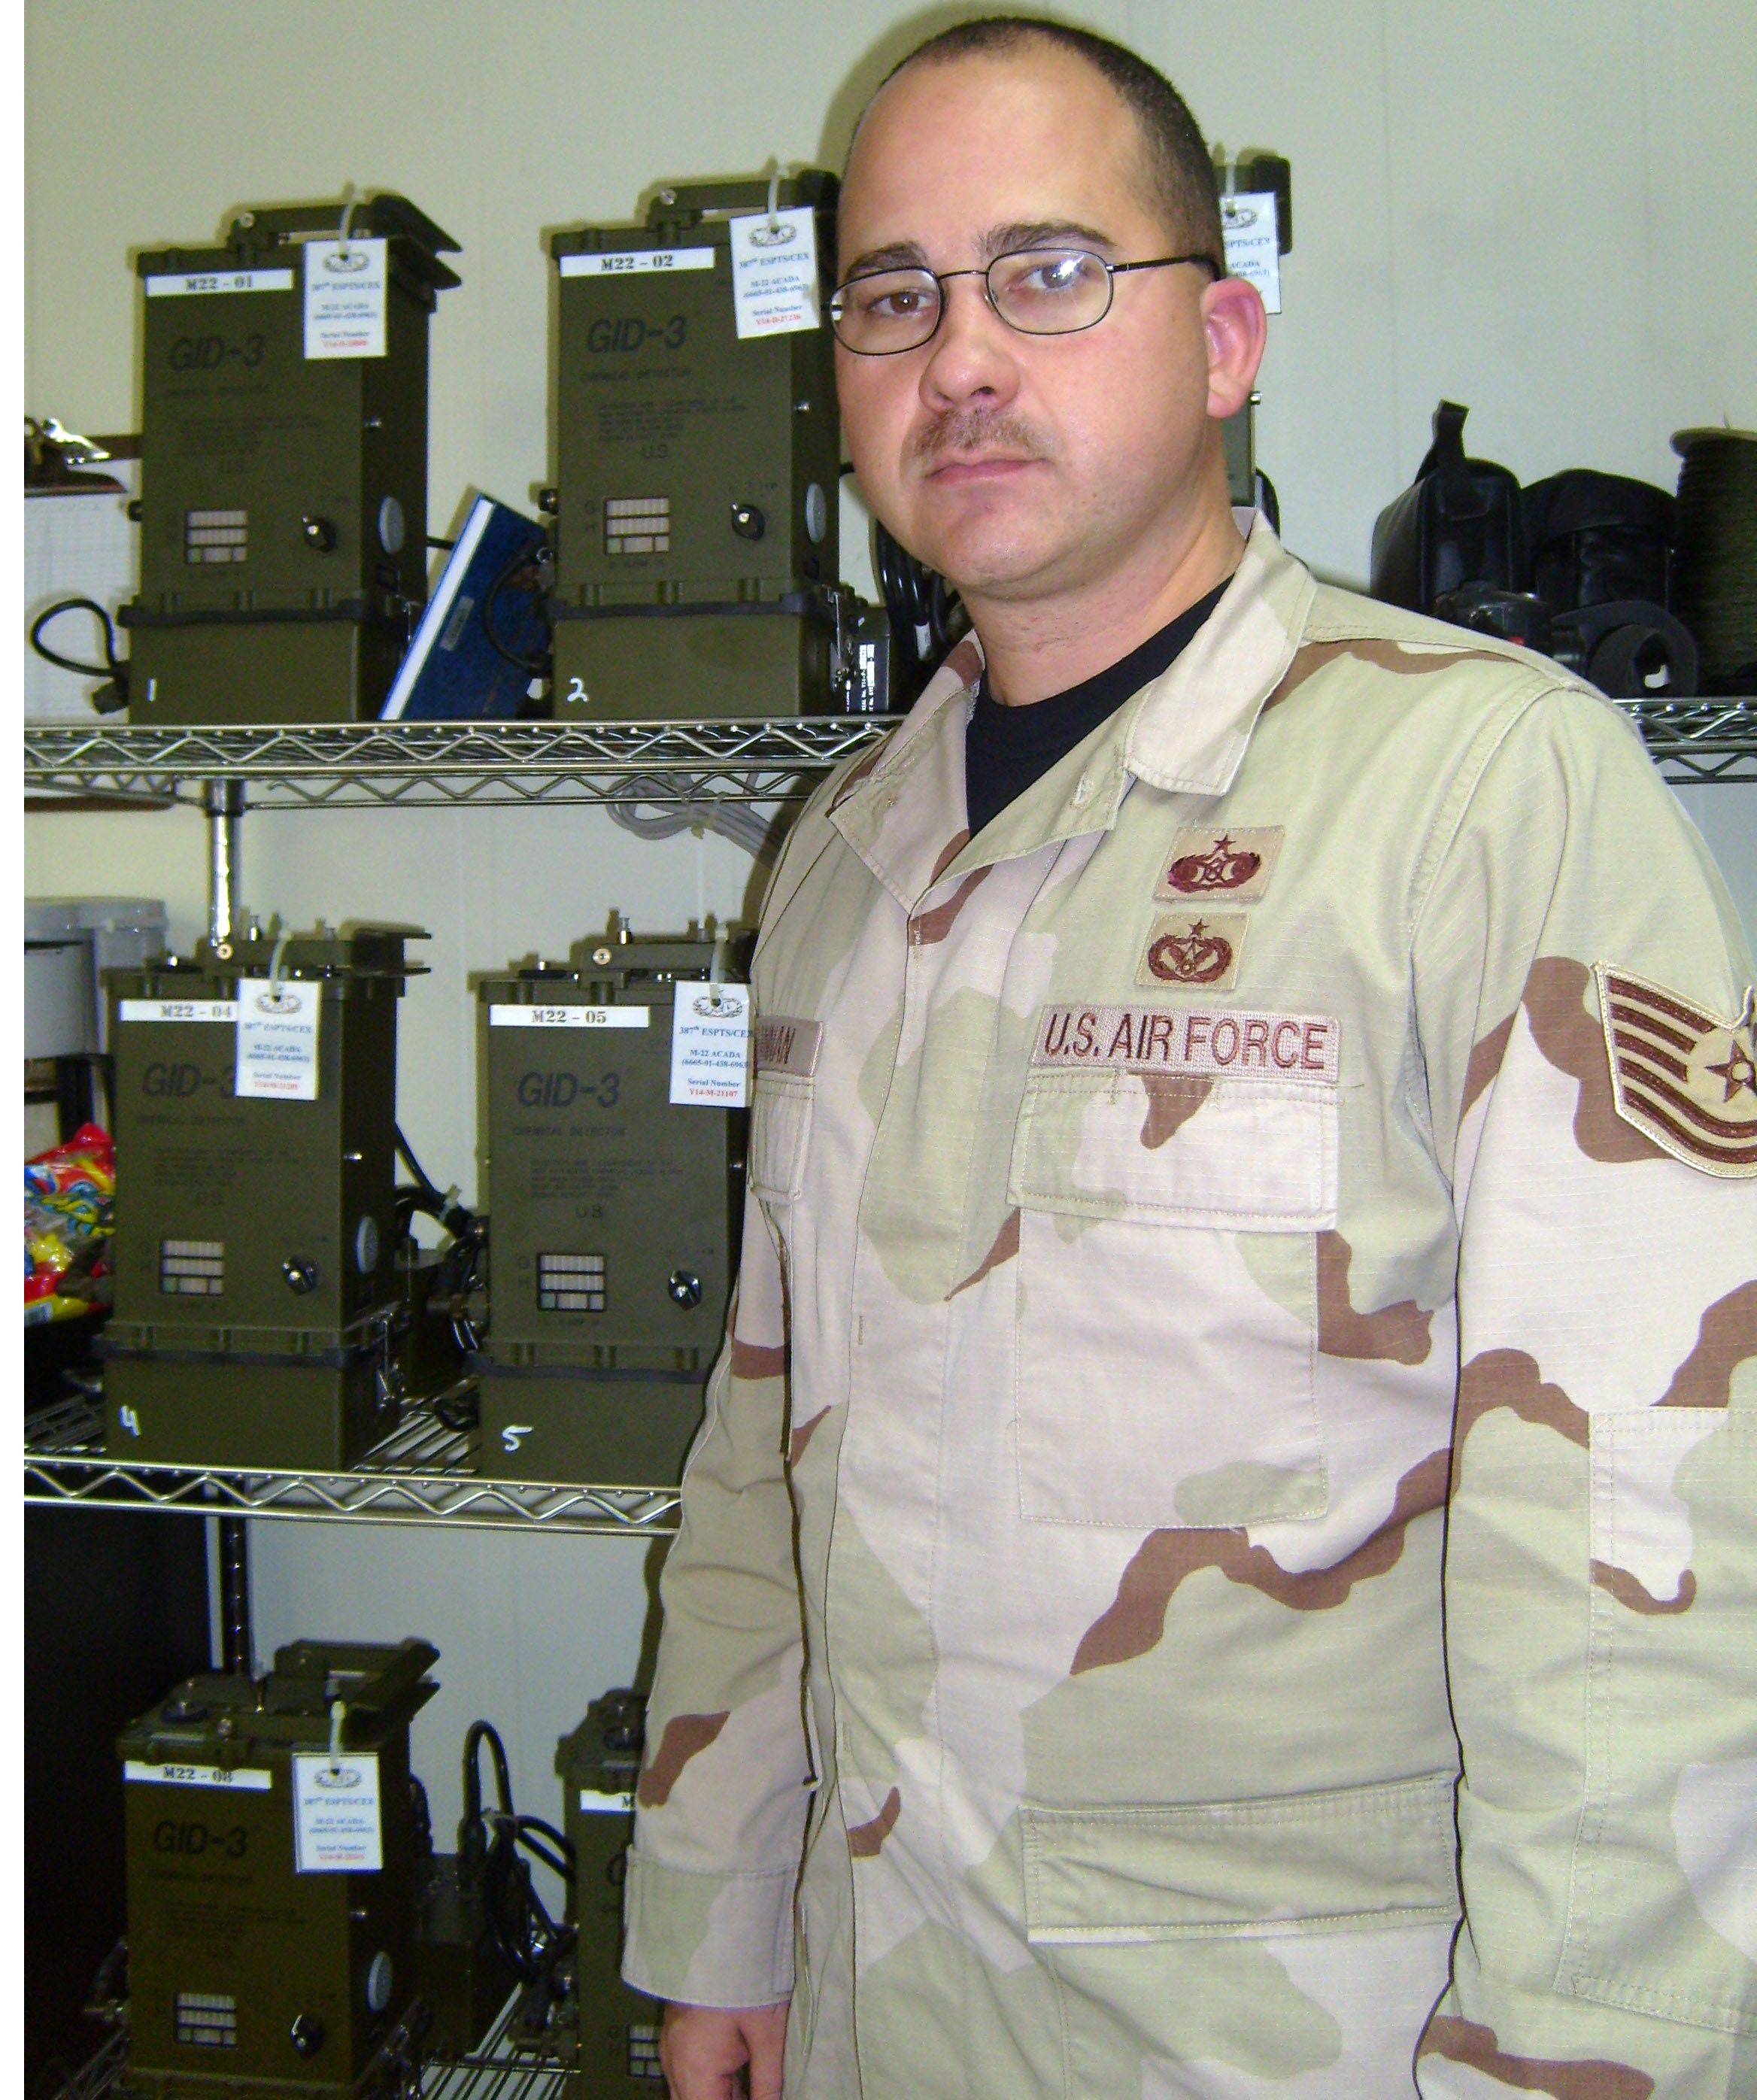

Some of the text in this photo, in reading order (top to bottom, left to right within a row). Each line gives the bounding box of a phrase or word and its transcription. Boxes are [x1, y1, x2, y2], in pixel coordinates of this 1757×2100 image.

[587, 313, 687, 354] GID-3
[168, 333, 266, 371] GID-3
[567, 677, 589, 703] 2
[690, 1048, 741, 1059] M-22 ACADA
[1045, 1012, 1328, 1070] U.S. AIR FORCE
[517, 1071, 620, 1108] GID-3
[687, 1077, 740, 1088] Serial Number
[120, 1405, 141, 1437] 4
[502, 1425, 535, 1452] 5
[154, 1820, 247, 1859] GID-3
